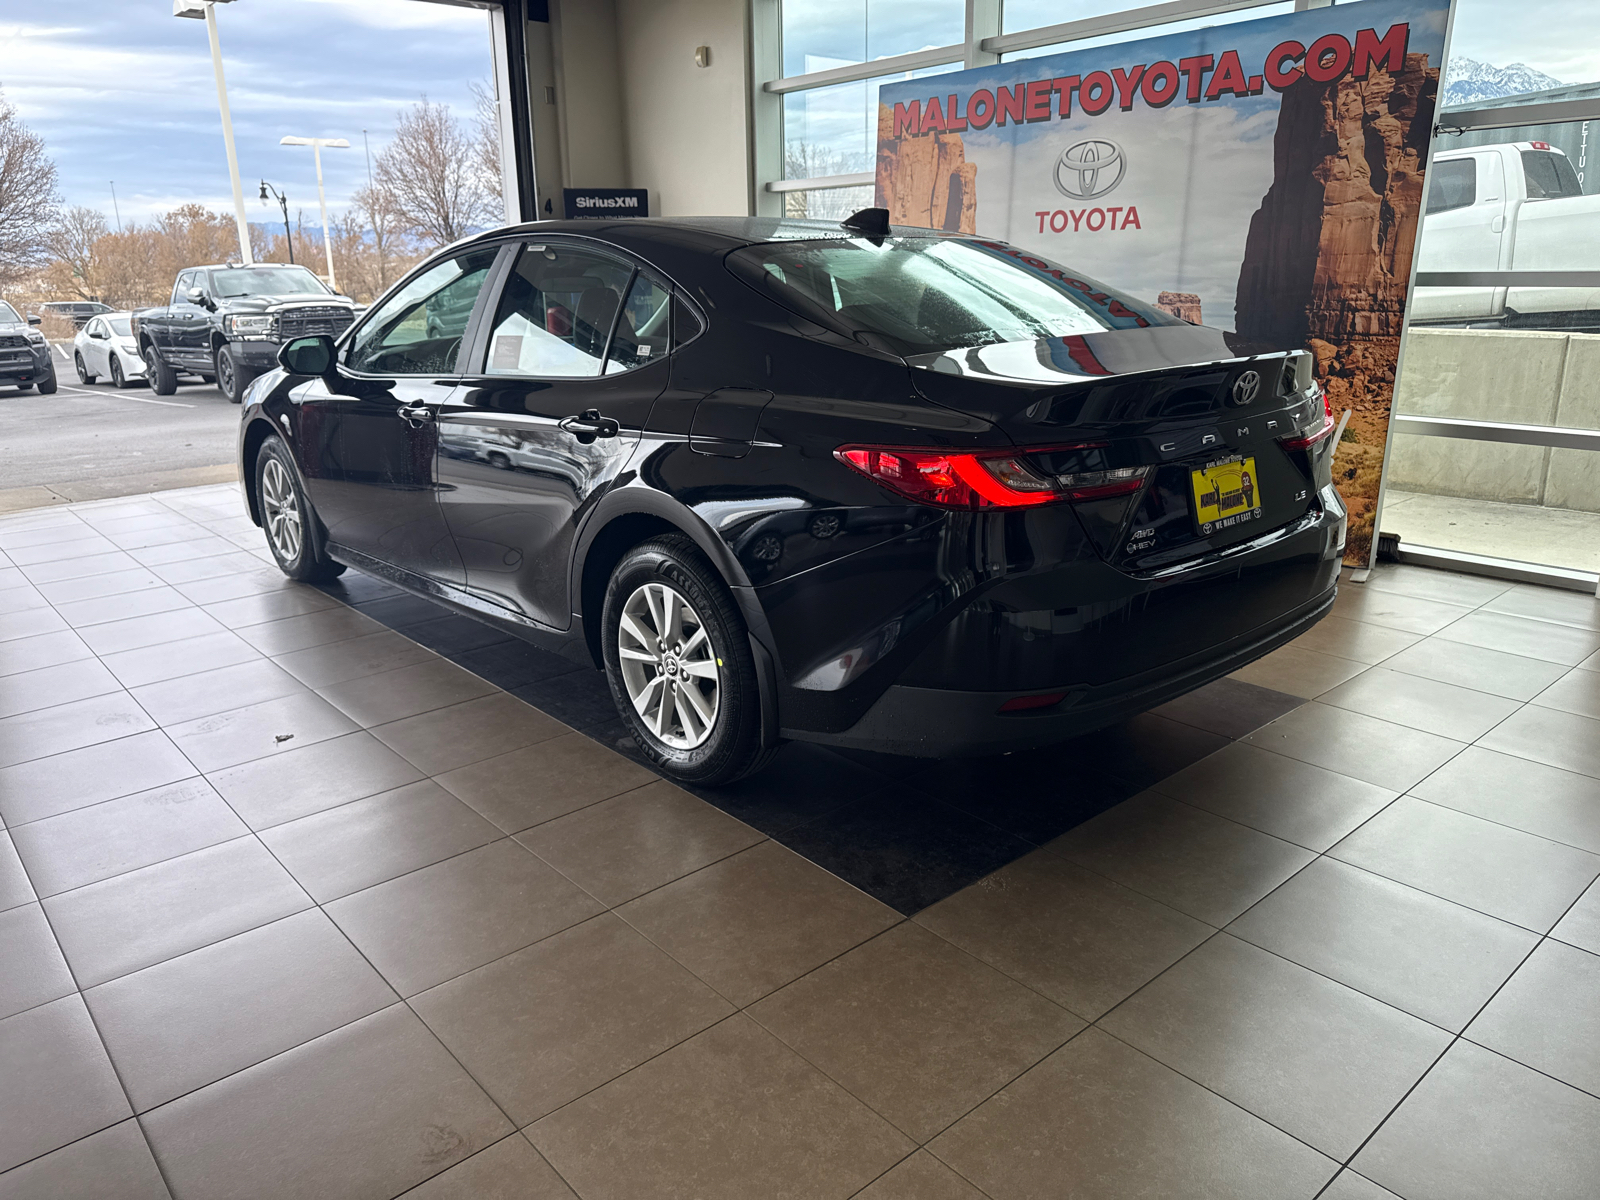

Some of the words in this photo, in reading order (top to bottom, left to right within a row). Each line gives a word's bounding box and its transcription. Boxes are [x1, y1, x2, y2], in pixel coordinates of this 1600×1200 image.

[892, 22, 1410, 140] MALONETOYOTA.COM
[544, 198, 553, 214] 4
[575, 197, 638, 208] SiriusXM
[1034, 206, 1142, 235] TOYOTA
[1243, 476, 1250, 486] 32
[1215, 522, 1223, 530] WE
[1223, 517, 1236, 527] MAKE
[1240, 512, 1252, 522] EASY
